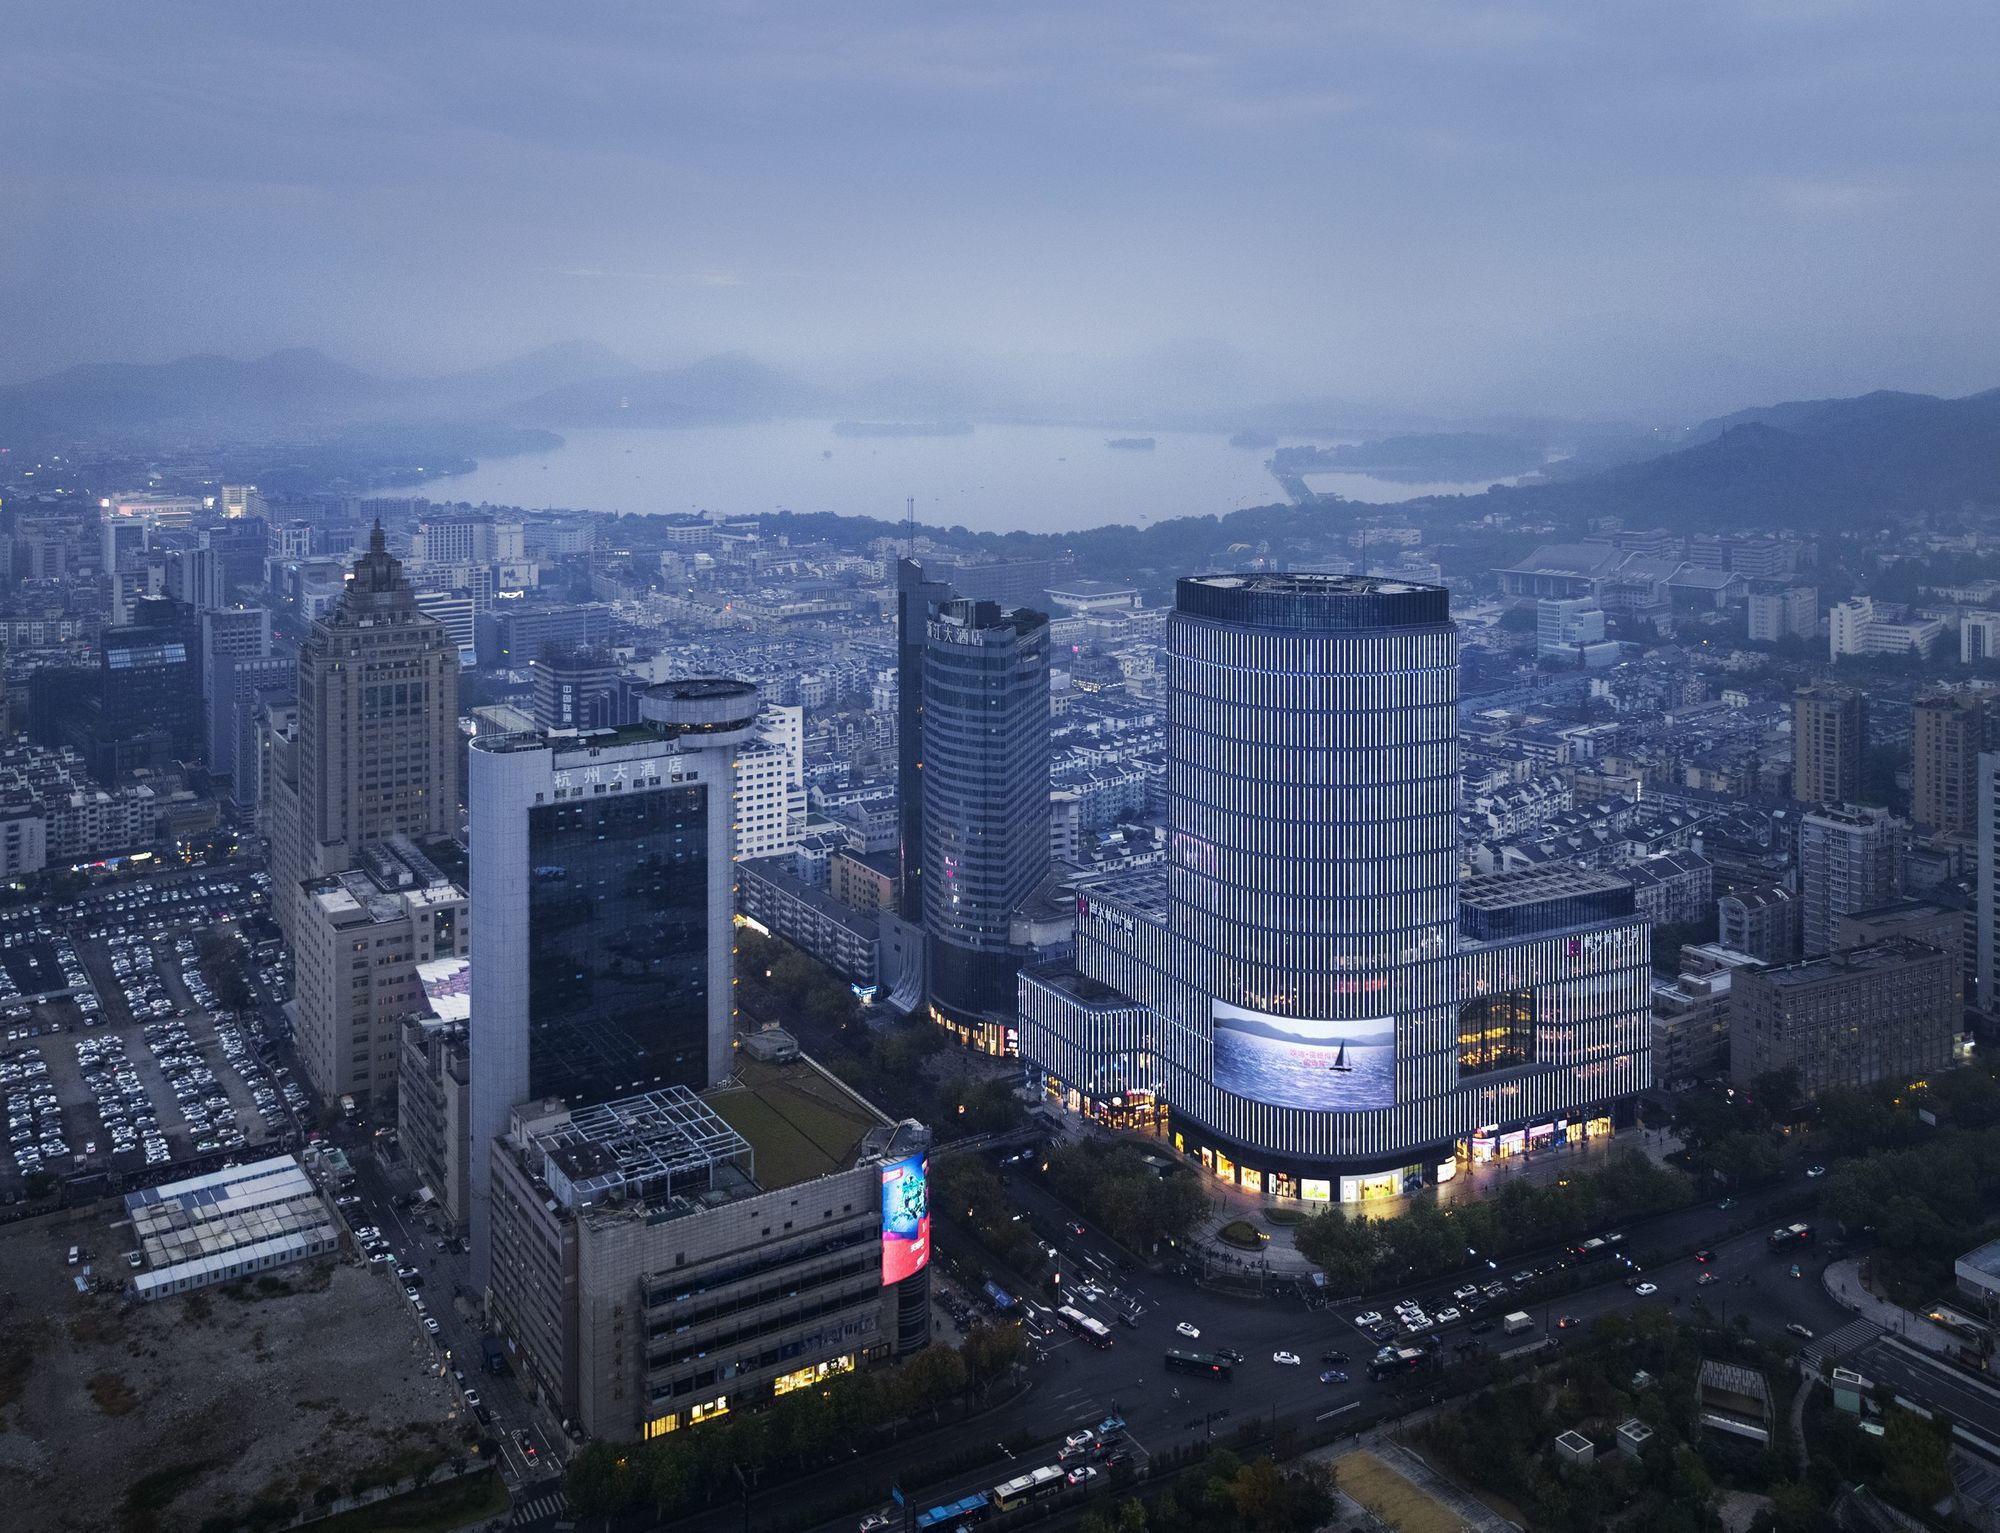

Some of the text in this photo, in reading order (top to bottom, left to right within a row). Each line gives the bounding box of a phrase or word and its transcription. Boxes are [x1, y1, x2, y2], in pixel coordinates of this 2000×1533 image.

[554, 756, 683, 788] 杭州大酒店
